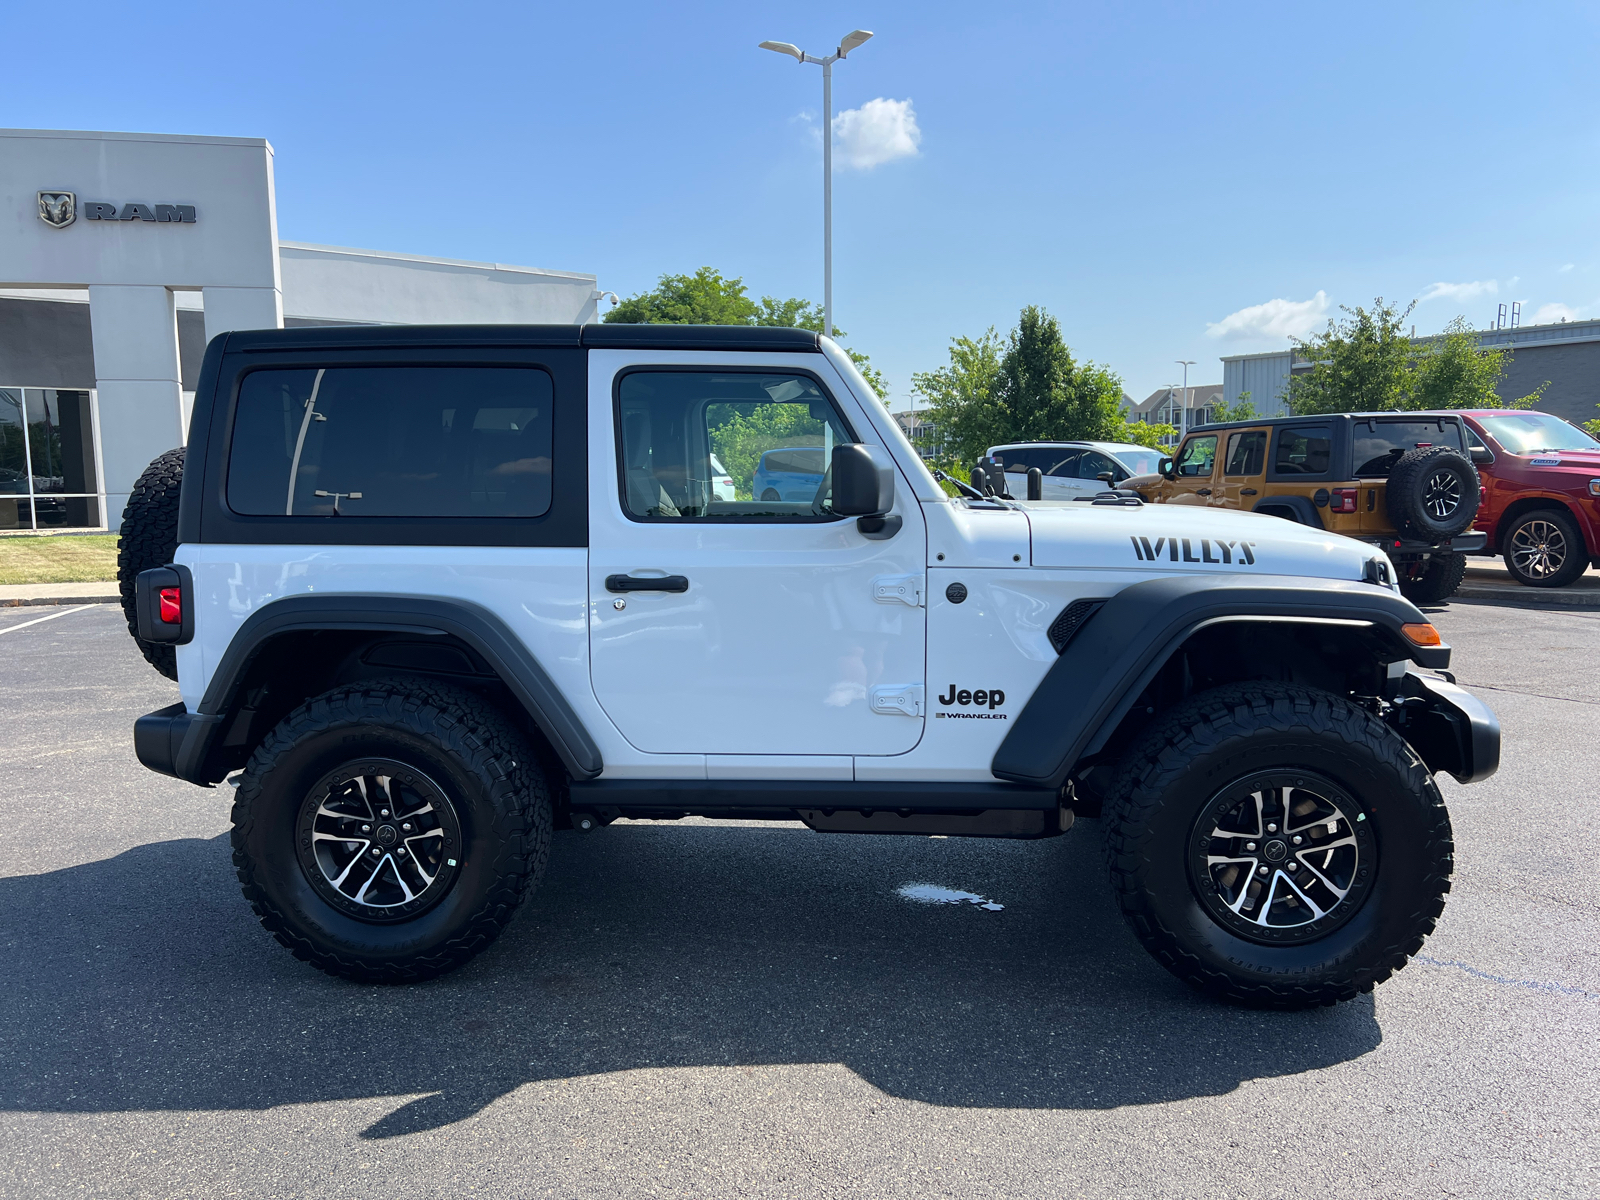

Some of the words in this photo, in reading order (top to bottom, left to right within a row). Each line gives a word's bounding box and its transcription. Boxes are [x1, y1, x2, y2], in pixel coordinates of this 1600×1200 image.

[84, 202, 196, 223] RAM
[1130, 536, 1256, 565] WILLYS
[938, 684, 1005, 709] Jeep
